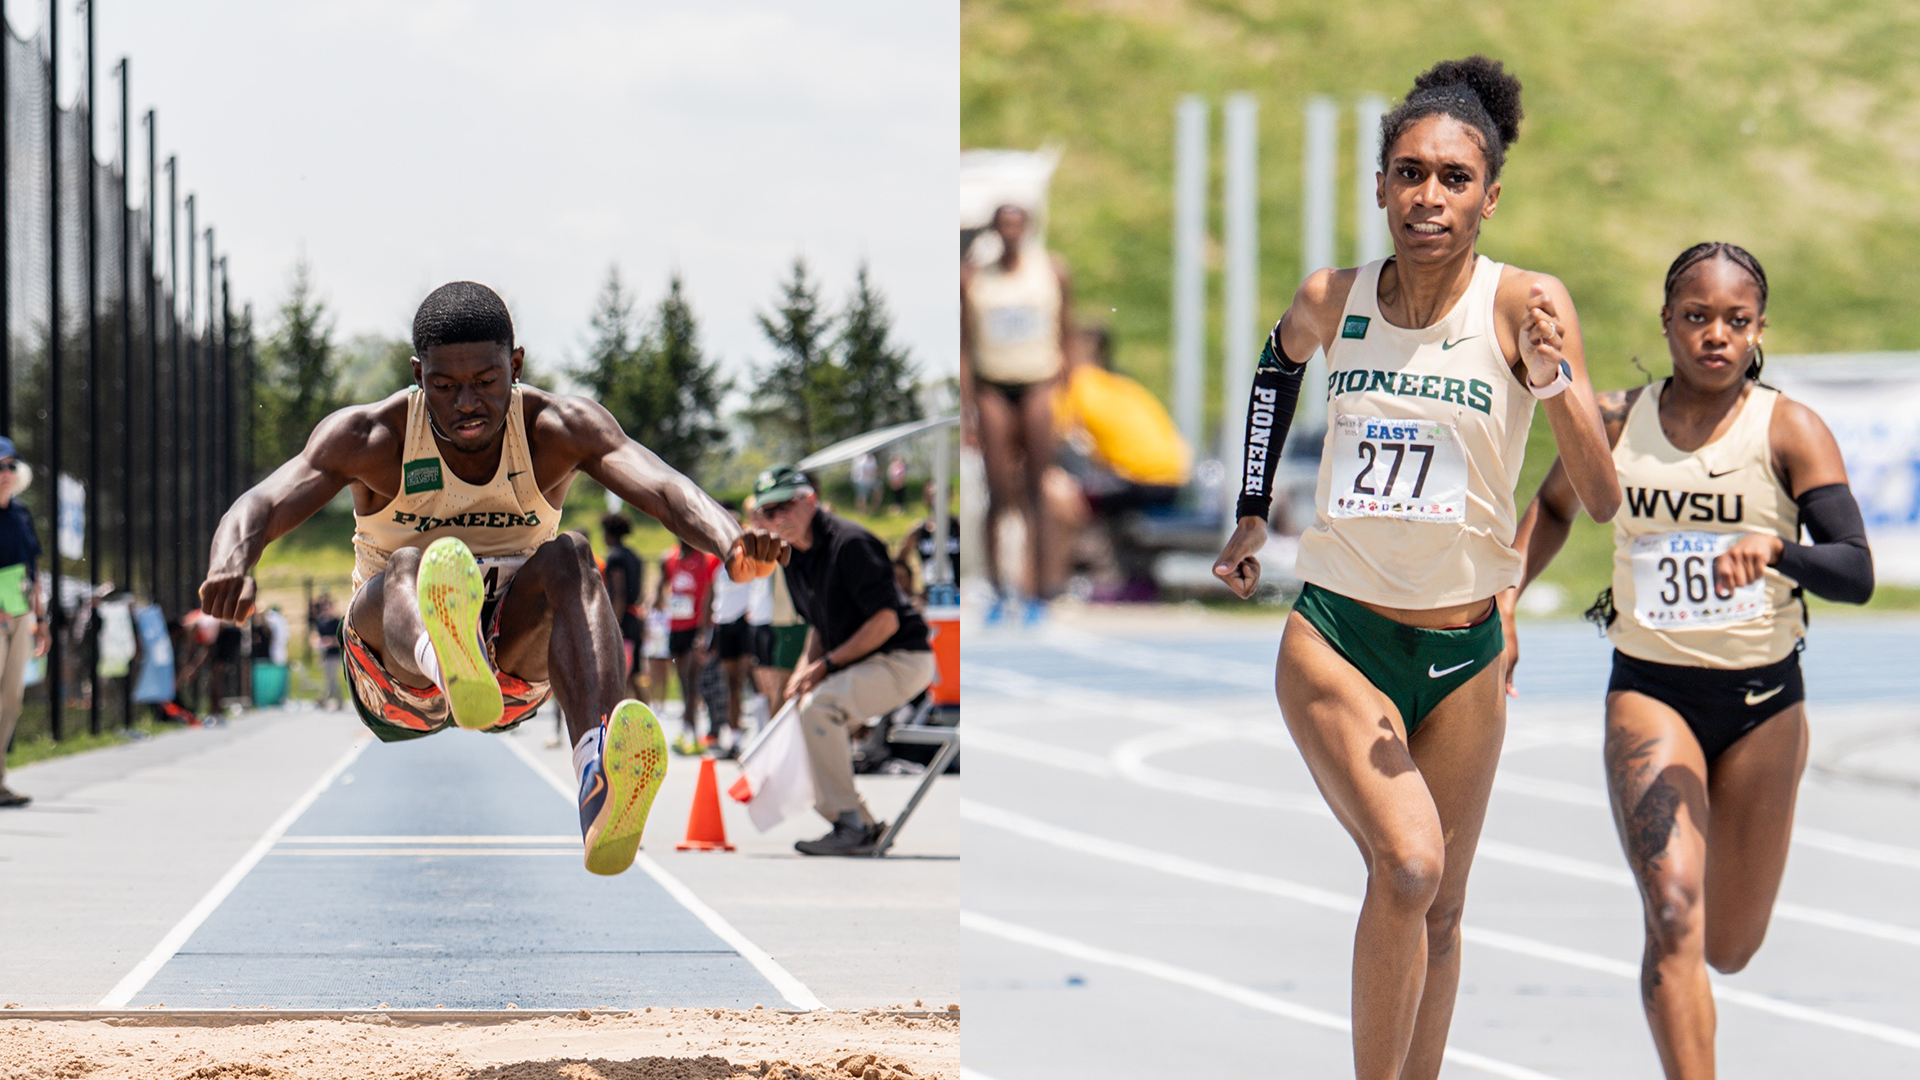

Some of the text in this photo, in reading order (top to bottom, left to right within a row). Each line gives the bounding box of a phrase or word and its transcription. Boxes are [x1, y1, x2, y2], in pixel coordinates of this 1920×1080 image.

[1326, 369, 1493, 416] PIONEERS
[1366, 424, 1419, 441] EAST
[1353, 440, 1435, 499] 277
[1626, 487, 1744, 524] WVSU
[392, 510, 541, 533] PIONEERS
[1670, 539, 1717, 553] EAST
